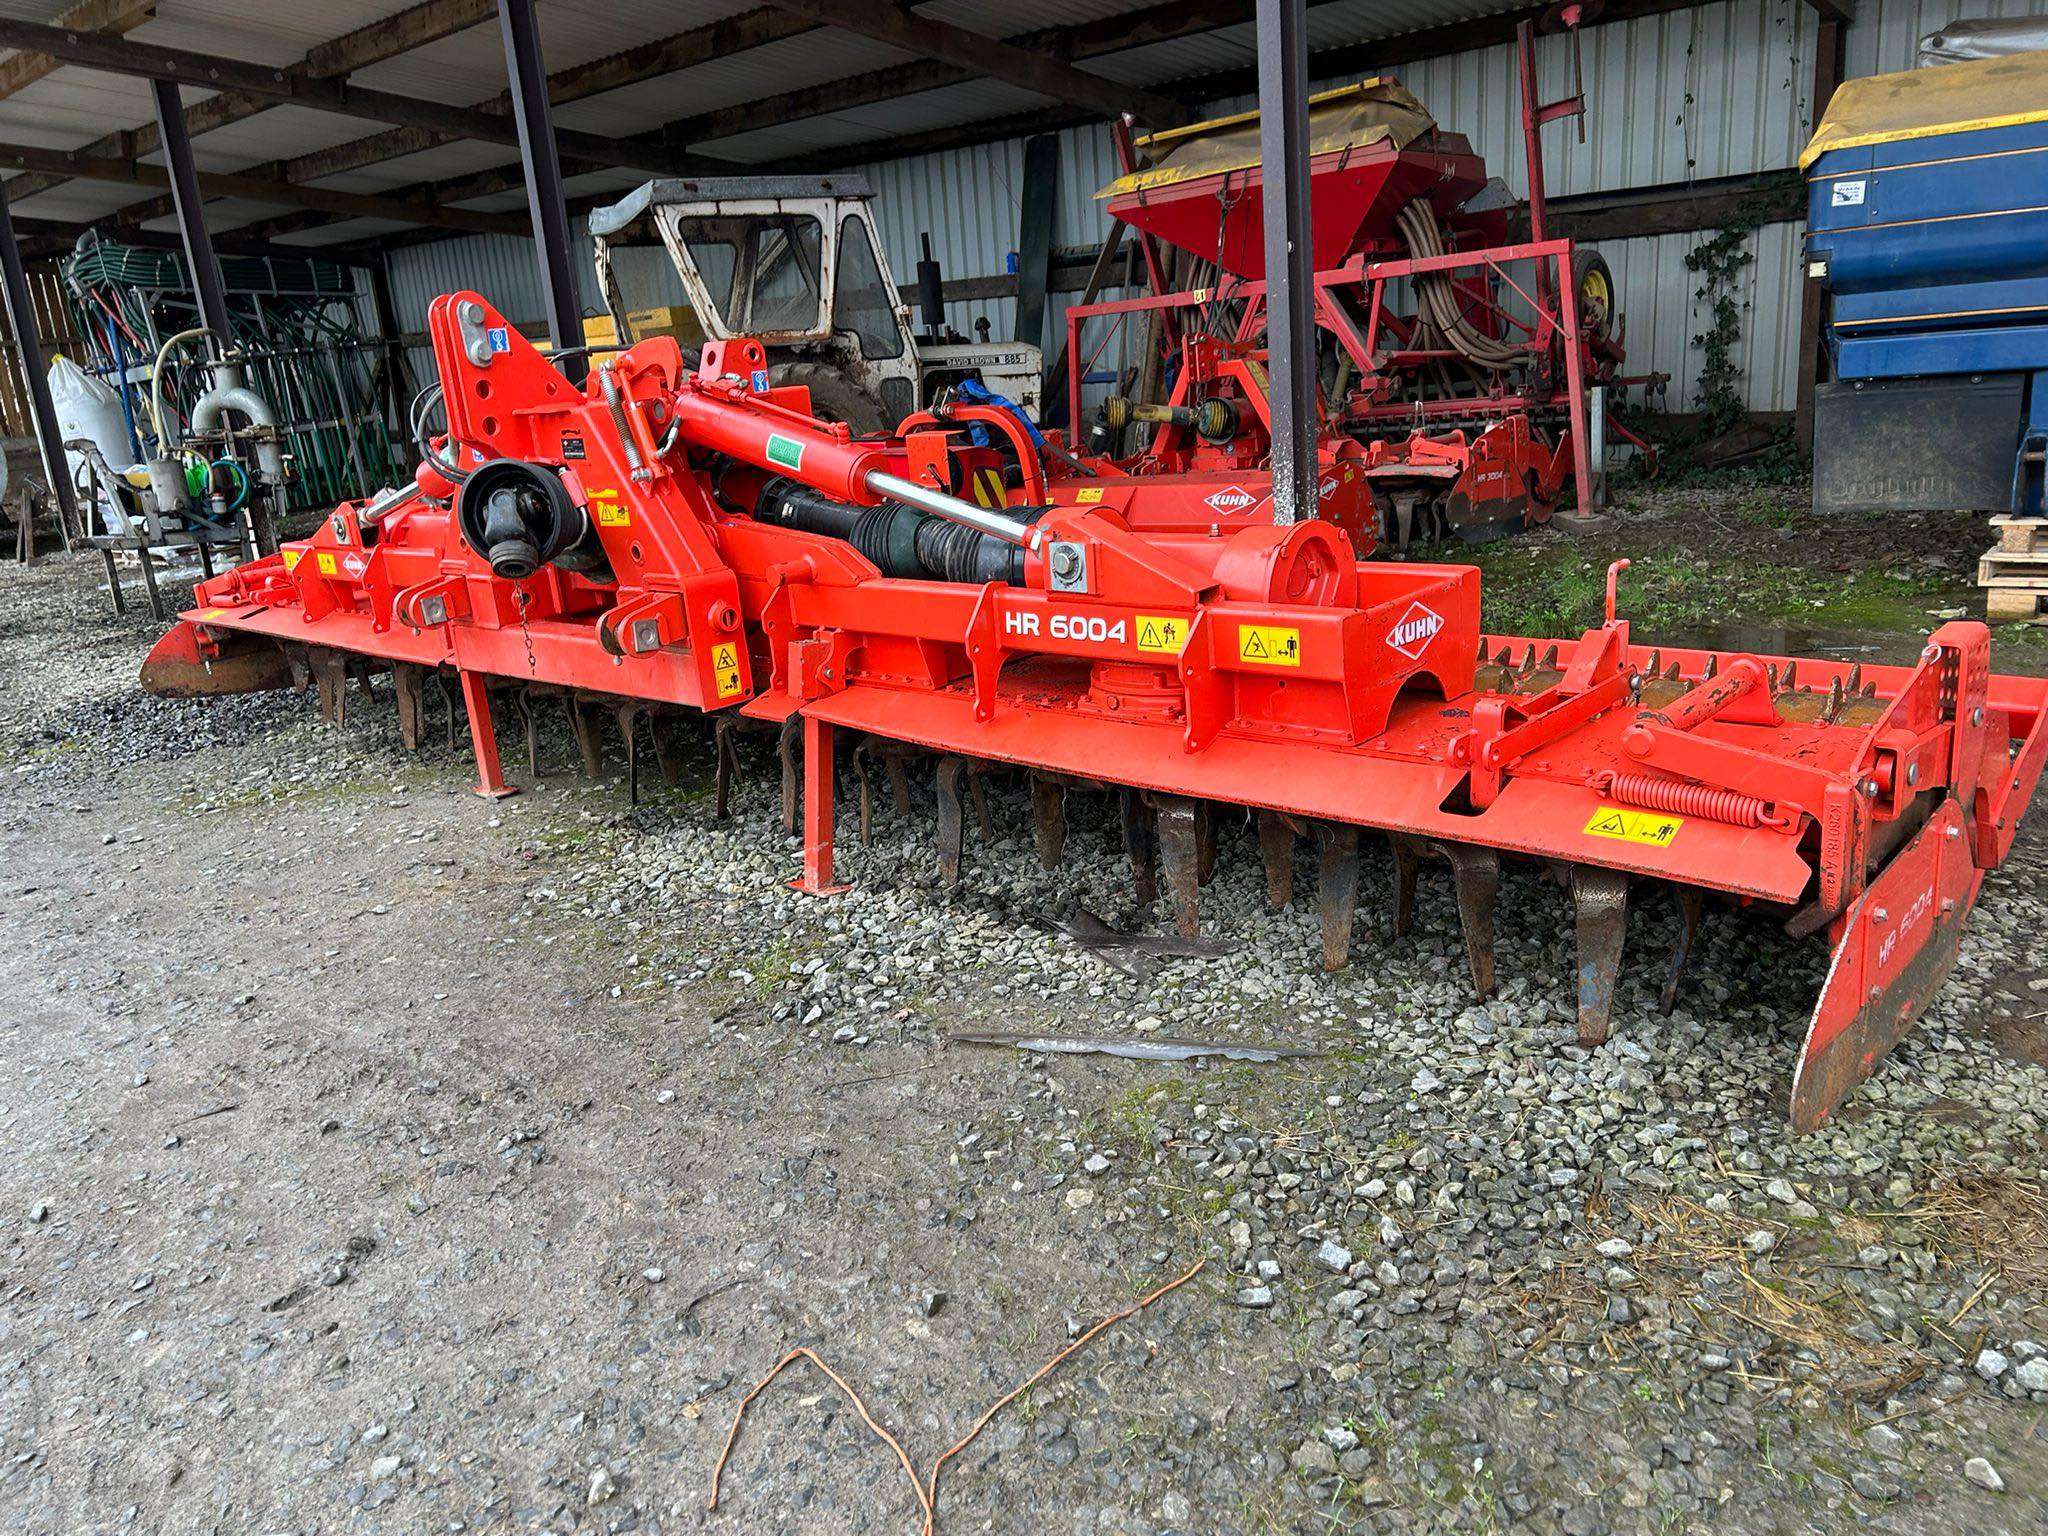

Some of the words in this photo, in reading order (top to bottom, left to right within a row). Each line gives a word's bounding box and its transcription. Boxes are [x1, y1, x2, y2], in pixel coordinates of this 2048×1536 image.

[946, 358, 969, 367] DAVID
[1004, 354, 1021, 365] 885
[1210, 494, 1249, 507] KUHN
[1005, 611, 1041, 637] HR
[1050, 615, 1127, 644] 6004
[1394, 614, 1438, 648] KUHN
[1878, 928, 1897, 968] HR
[1899, 884, 1934, 938] 6004
